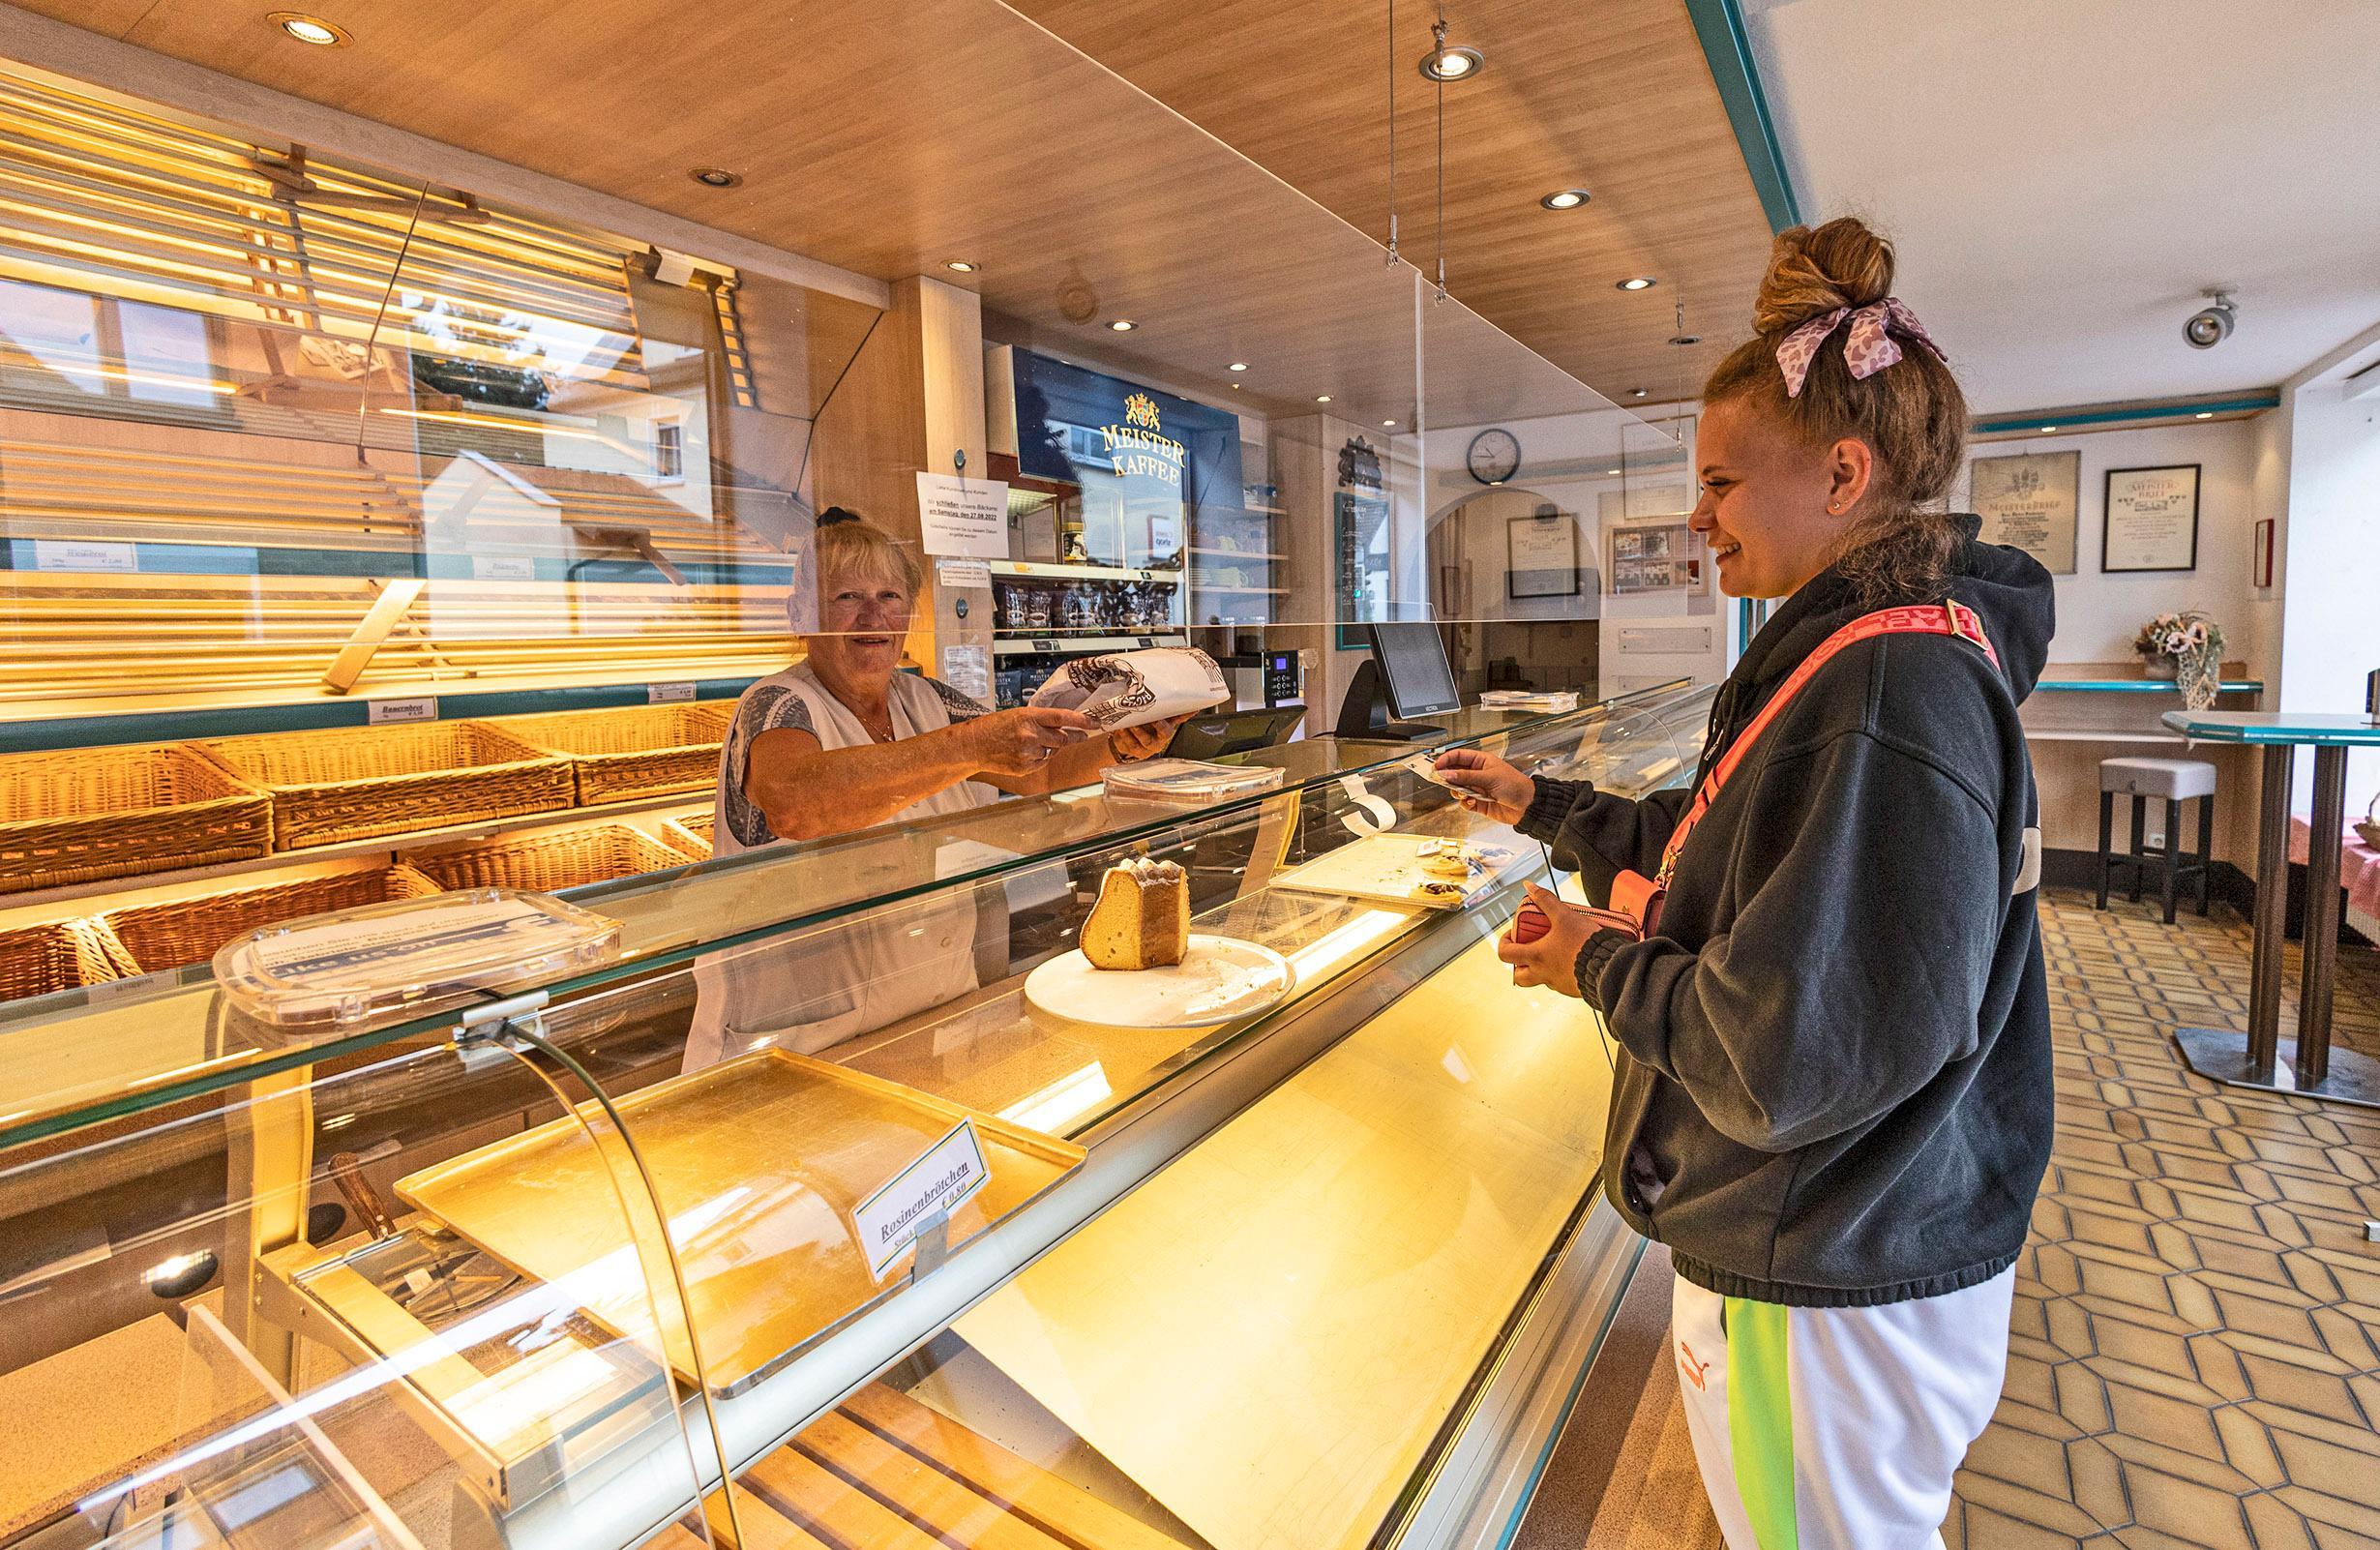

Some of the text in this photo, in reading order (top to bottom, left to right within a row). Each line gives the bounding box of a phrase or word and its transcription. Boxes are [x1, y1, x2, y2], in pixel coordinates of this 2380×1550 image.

[1100, 424, 1185, 468] MEISTER
[1112, 455, 1179, 488] KAFFEE
[976, 503, 997, 512] Bäckerei
[270, 960, 340, 979] Like
[349, 950, 388, 962] us
[881, 1162, 968, 1241] Rosinenbrötchen
[949, 1182, 967, 1204] 0,80
